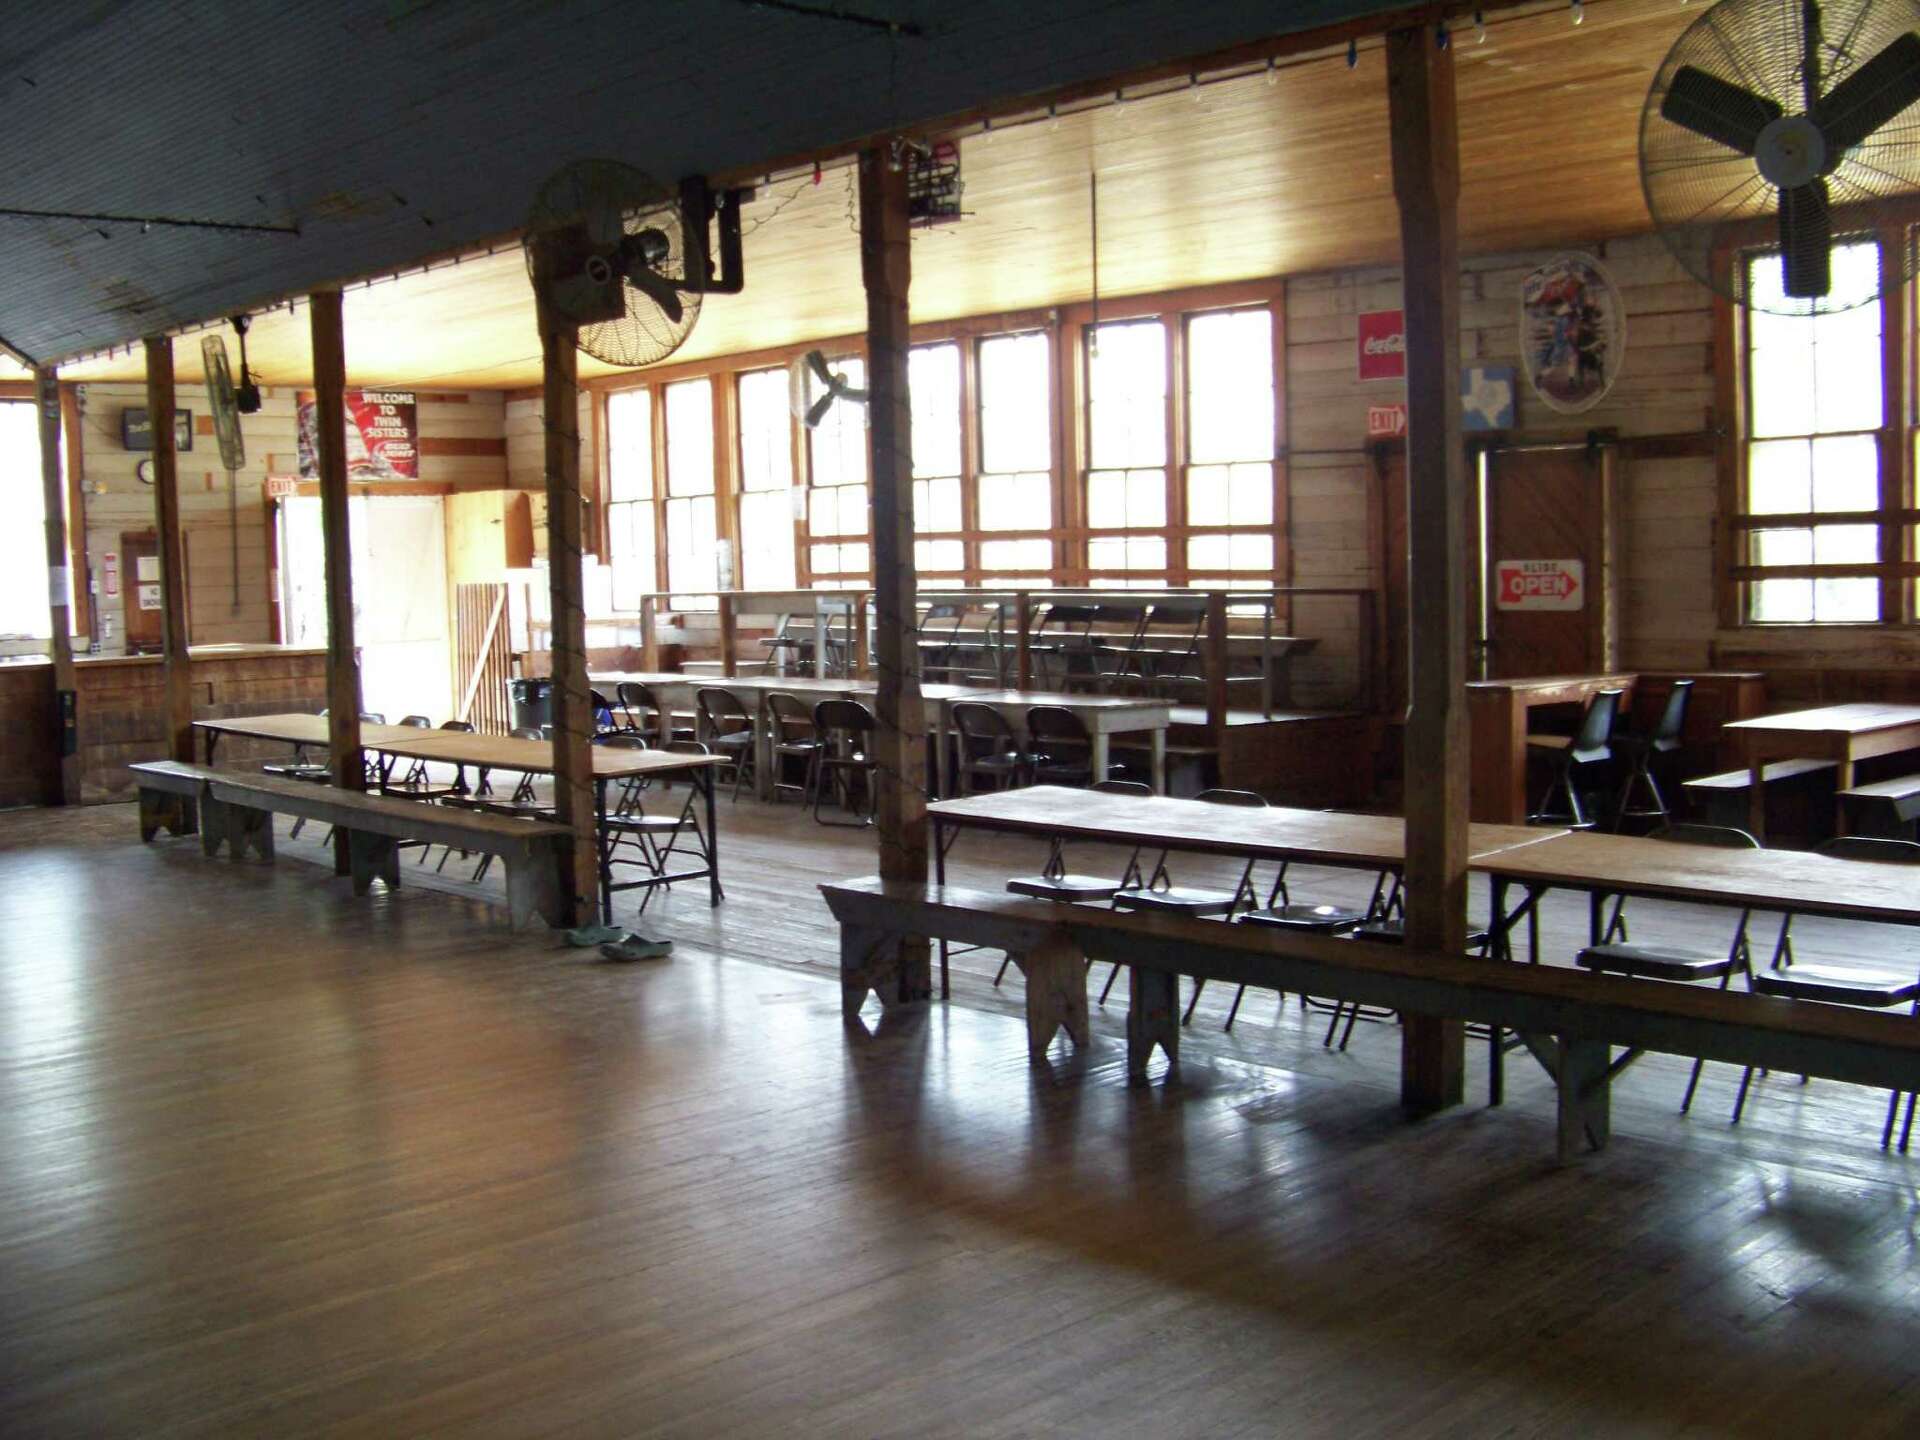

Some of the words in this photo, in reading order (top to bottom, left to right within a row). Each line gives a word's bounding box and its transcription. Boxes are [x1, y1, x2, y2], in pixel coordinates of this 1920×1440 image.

[362, 392, 415, 404] WELCOME
[380, 405, 396, 416] TO
[373, 416, 402, 427] TWIN
[1370, 411, 1398, 432] EXIT
[366, 427, 408, 438] SISTERS
[1510, 576, 1567, 594] OPEN
